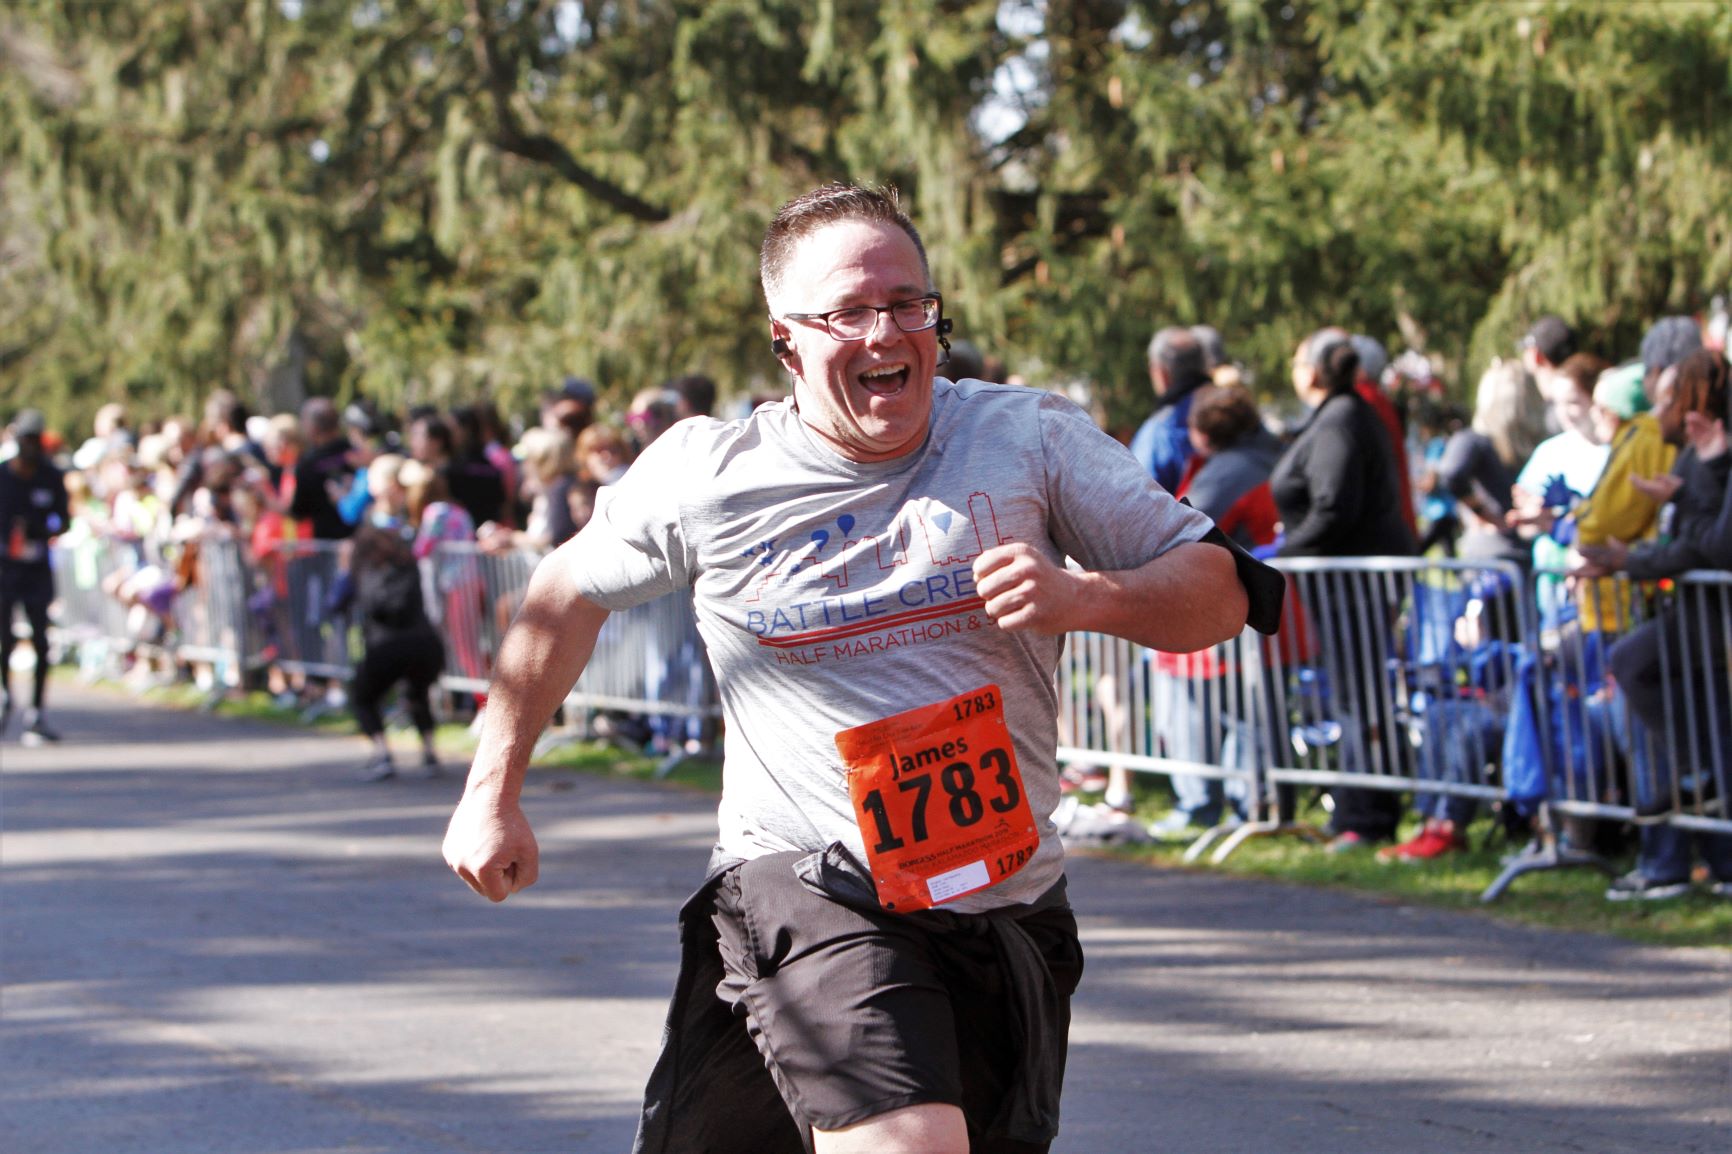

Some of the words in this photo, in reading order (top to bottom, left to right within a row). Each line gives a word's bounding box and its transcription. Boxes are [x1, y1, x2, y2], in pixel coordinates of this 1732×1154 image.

[747, 590, 887, 635] BATTLE
[898, 567, 975, 608] CRE
[776, 647, 826, 666] HALF
[833, 619, 961, 660] MARATHON
[967, 615, 981, 630] &
[986, 614, 997, 626] 5
[953, 692, 996, 721] 1783
[890, 737, 968, 780] James
[862, 748, 1020, 855] 1783
